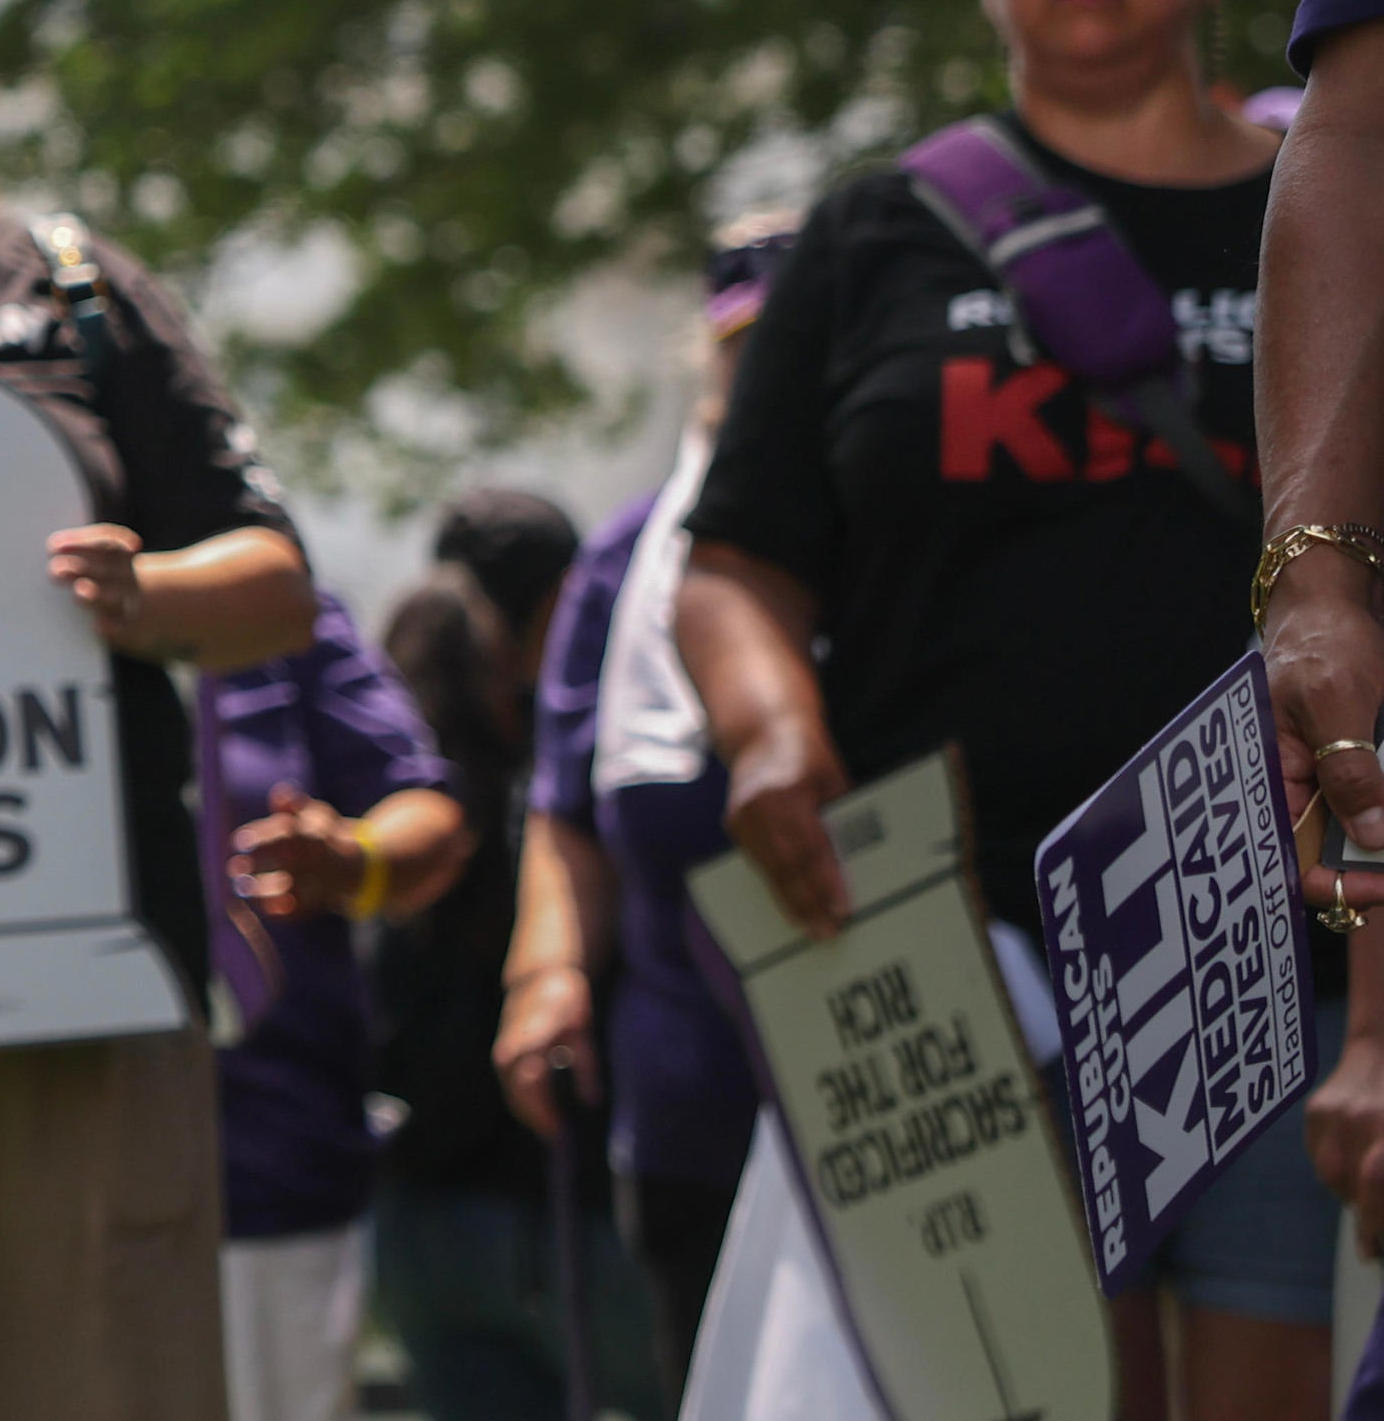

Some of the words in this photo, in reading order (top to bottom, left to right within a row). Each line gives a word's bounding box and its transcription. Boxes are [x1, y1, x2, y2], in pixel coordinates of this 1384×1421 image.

[1199, 706, 1254, 906] LIVES
[1232, 680, 1280, 877] Medicaid
[1101, 758, 1210, 1222] KILL
[1167, 739, 1246, 1152] MEDICAID
[1264, 884, 1289, 950] Off
[827, 960, 918, 1051] RICH
[895, 1014, 975, 1097] FOR
[1048, 855, 1127, 1276] REPUBLICAN
[1092, 953, 1131, 1123] CUTS
[1233, 905, 1275, 1115] SAVES
[1276, 955, 1303, 1091] Hands
[817, 1055, 898, 1131] THE
[820, 1074, 1026, 1208] SACRIFICED
